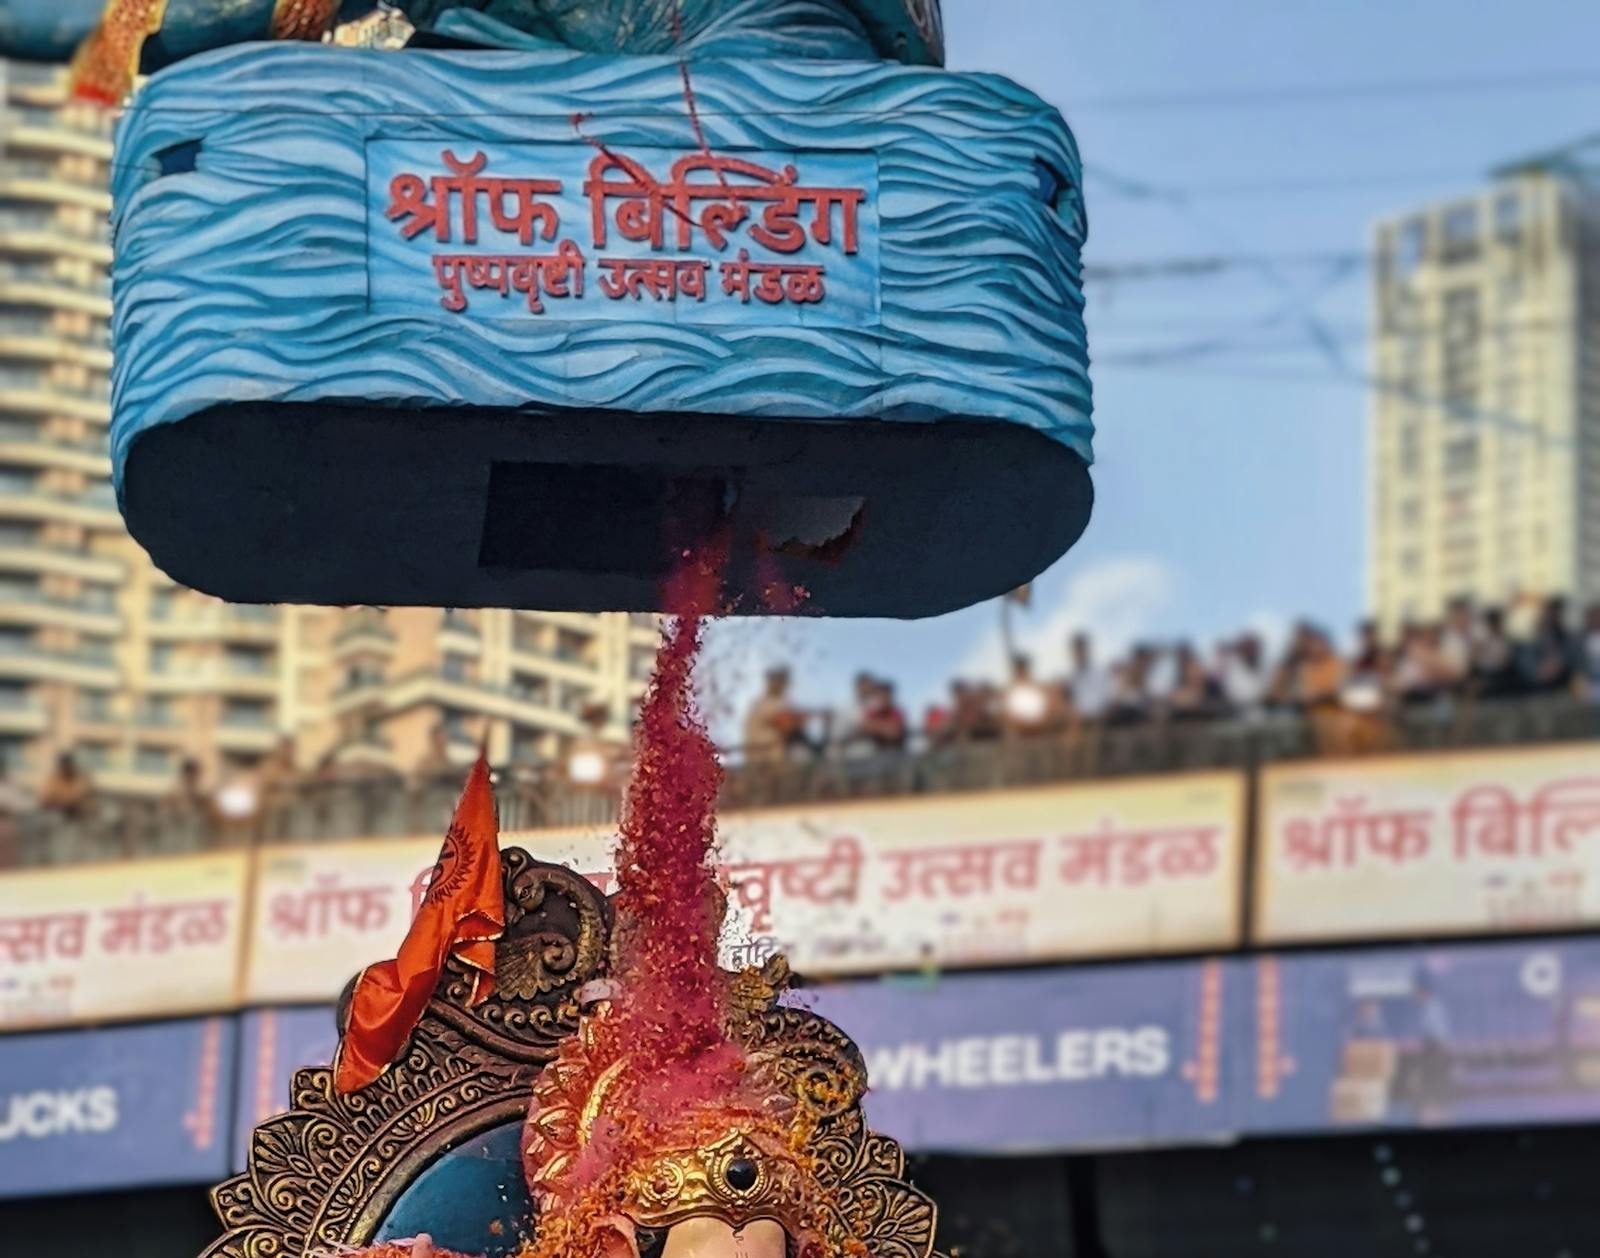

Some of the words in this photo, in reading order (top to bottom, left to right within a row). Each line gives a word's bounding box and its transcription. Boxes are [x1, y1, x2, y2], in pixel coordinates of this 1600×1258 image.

[384, 148, 563, 246] श्रॉफ
[583, 153, 868, 255] बिल्डिंग
[598, 258, 709, 301] उत्सव
[720, 249, 826, 303] मंडळ
[881, 838, 1044, 902] उत्सव
[866, 1025, 1172, 1092] WHEELERS
